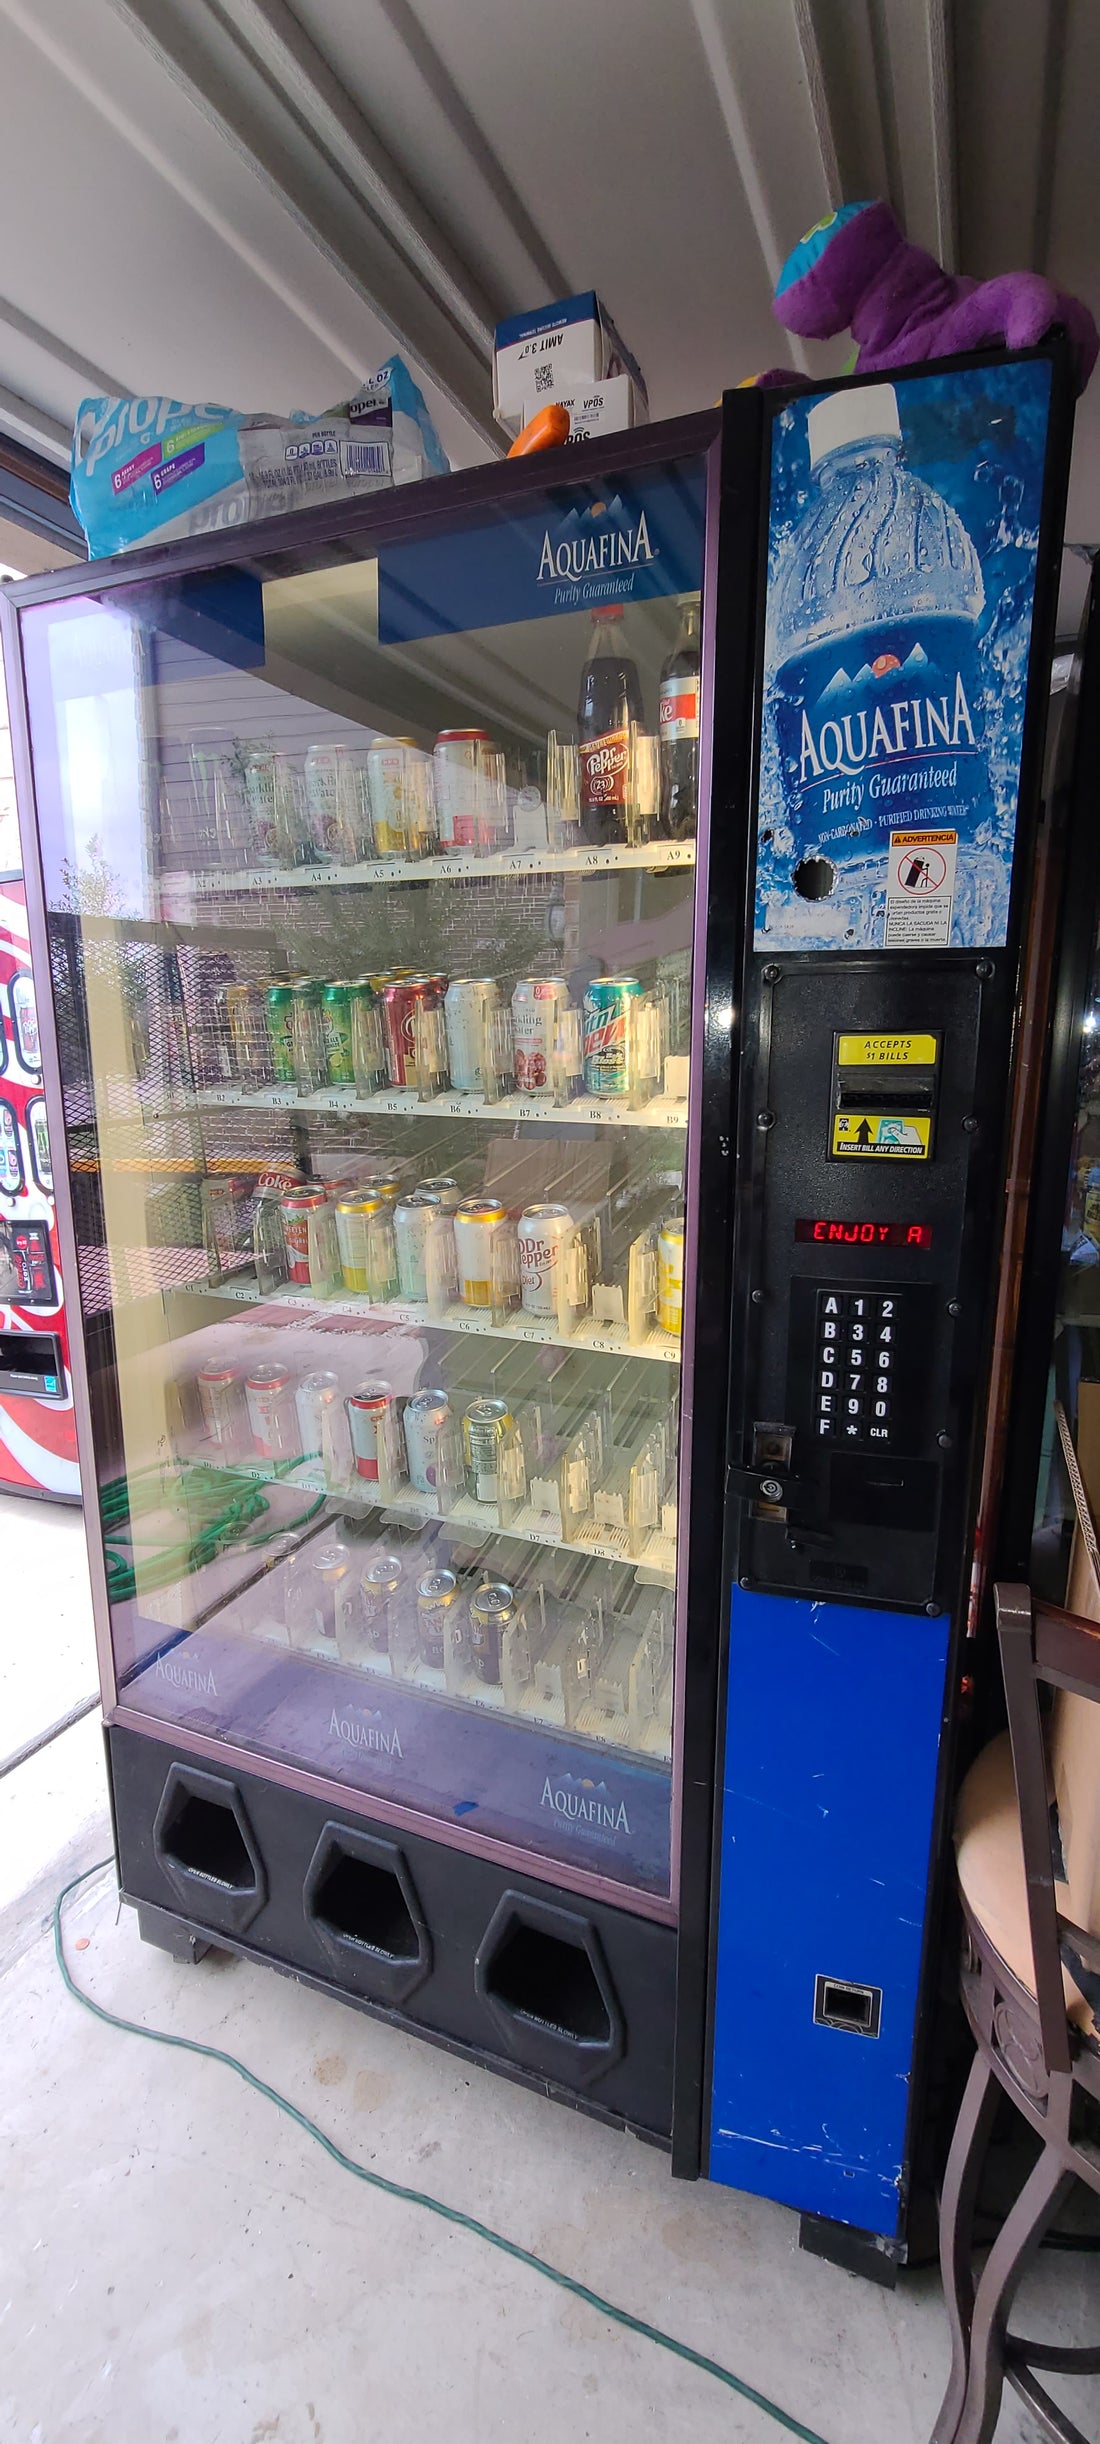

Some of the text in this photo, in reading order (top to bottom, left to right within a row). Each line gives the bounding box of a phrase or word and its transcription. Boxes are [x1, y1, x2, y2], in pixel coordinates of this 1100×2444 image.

[525, 333, 564, 354] AMIT 3.0
[583, 397, 604, 409] VPOS
[166, 440, 175, 453] 6
[114, 474, 122, 489] 6
[153, 474, 162, 489] 6
[536, 510, 654, 582] AQUAFINA
[554, 572, 635, 606] Purity Guaranteed
[800, 672, 976, 783] AQUAFINA
[590, 750, 627, 776] Pepper
[596, 780, 606, 790] 23
[822, 761, 958, 814] Purity Guaranteed
[879, 810, 912, 827] PURIFIED
[914, 806, 947, 821] DRINKING
[902, 834, 954, 843] ADVERTENCIA
[252, 876, 263, 886] A3
[311, 872, 322, 881] A4
[373, 869, 384, 878] A5
[440, 864, 452, 874] A6
[510, 859, 522, 869] A7
[585, 855, 599, 865] A8
[667, 850, 681, 861] A9
[864, 1040, 912, 1049] ACCEPTS
[866, 1052, 909, 1060] $1 BILLS
[329, 1101, 339, 1109] B4
[387, 1103, 397, 1111] B5
[450, 1105, 461, 1113] B6
[519, 1109, 530, 1118] B7
[589, 1110, 602, 1119] B8
[666, 1116, 679, 1124] B9
[840, 1142, 923, 1154] INSERT BILL ANY DIRECTION
[258, 1172, 292, 1192] Coke
[813, 1221, 922, 1244] ENJOY A
[526, 1237, 545, 1254] Dr
[825, 1297, 894, 1318] A 1 2
[235, 1291, 246, 1299] C2
[287, 1298, 297, 1306] C3
[399, 1313, 410, 1321] C5
[459, 1322, 471, 1331] C6
[523, 1330, 535, 1339] C7
[592, 1340, 605, 1349] C8
[663, 1351, 676, 1360] C9
[824, 1322, 891, 1343] B 3 4
[823, 1347, 890, 1368] C 5 6
[821, 1371, 888, 1393] D 7 8
[820, 1395, 886, 1417] E 9 0
[819, 1419, 830, 1435] F
[870, 1427, 888, 1438] CLR
[252, 1471, 261, 1479] D2
[529, 1534, 540, 1542] D7
[155, 1652, 218, 1697] AQUAFINA
[328, 1708, 403, 1758] AQUAFINA
[540, 1776, 632, 1835] AQUAFINA
[199, 1871, 217, 1883] BOTTLES
